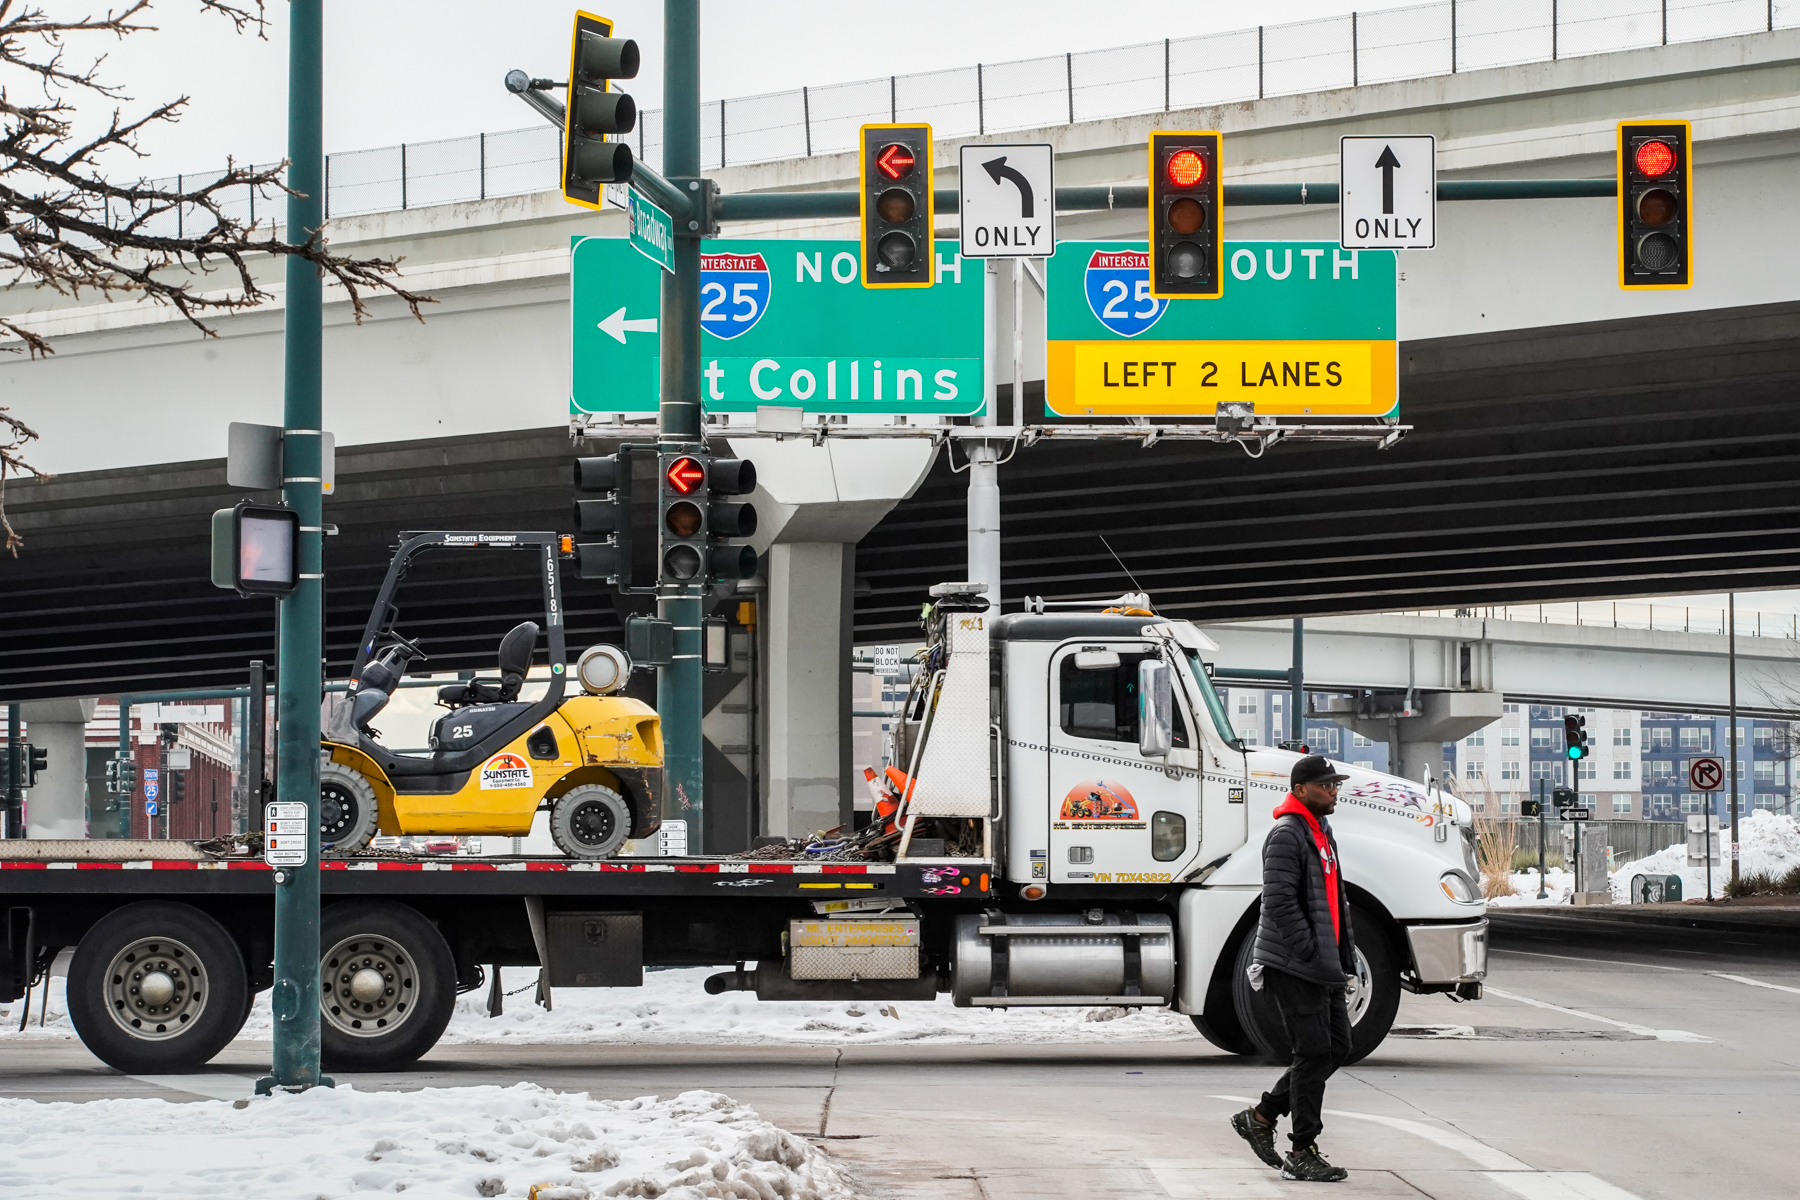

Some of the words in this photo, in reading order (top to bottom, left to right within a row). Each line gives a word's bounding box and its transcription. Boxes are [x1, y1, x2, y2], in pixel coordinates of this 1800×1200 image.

[636, 200, 668, 263] Broadway
[1355, 217, 1422, 239] ONLY
[974, 226, 1041, 247] ONLY
[700, 258, 757, 270] NTERSTATE
[796, 251, 962, 285] NOH
[1098, 256, 1150, 268] INTERSTAT
[1230, 248, 1359, 280] OUTH
[700, 282, 758, 322] 25
[1102, 279, 1160, 319] 25
[704, 361, 725, 400] t
[749, 358, 959, 401] Collins
[1103, 361, 1177, 388] LEFT
[1200, 361, 1219, 388] 2
[1241, 361, 1343, 388] LANES
[546, 545, 558, 626] 165187
[875, 647, 884, 655] DO
[886, 647, 899, 655] NOT
[875, 657, 898, 666] BLOCK
[452, 724, 474, 739] 25
[483, 769, 530, 780] SUNSTATE
[147, 786, 156, 797] 25
[1229, 790, 1243, 799] CAT
[1033, 866, 1045, 876] 54
[1093, 872, 1112, 882] VIN
[1115, 872, 1172, 882] 7DX43822
[806, 924, 823, 933] ML
[827, 924, 904, 933] ENTERPRISES
[801, 936, 840, 945] USDOT
